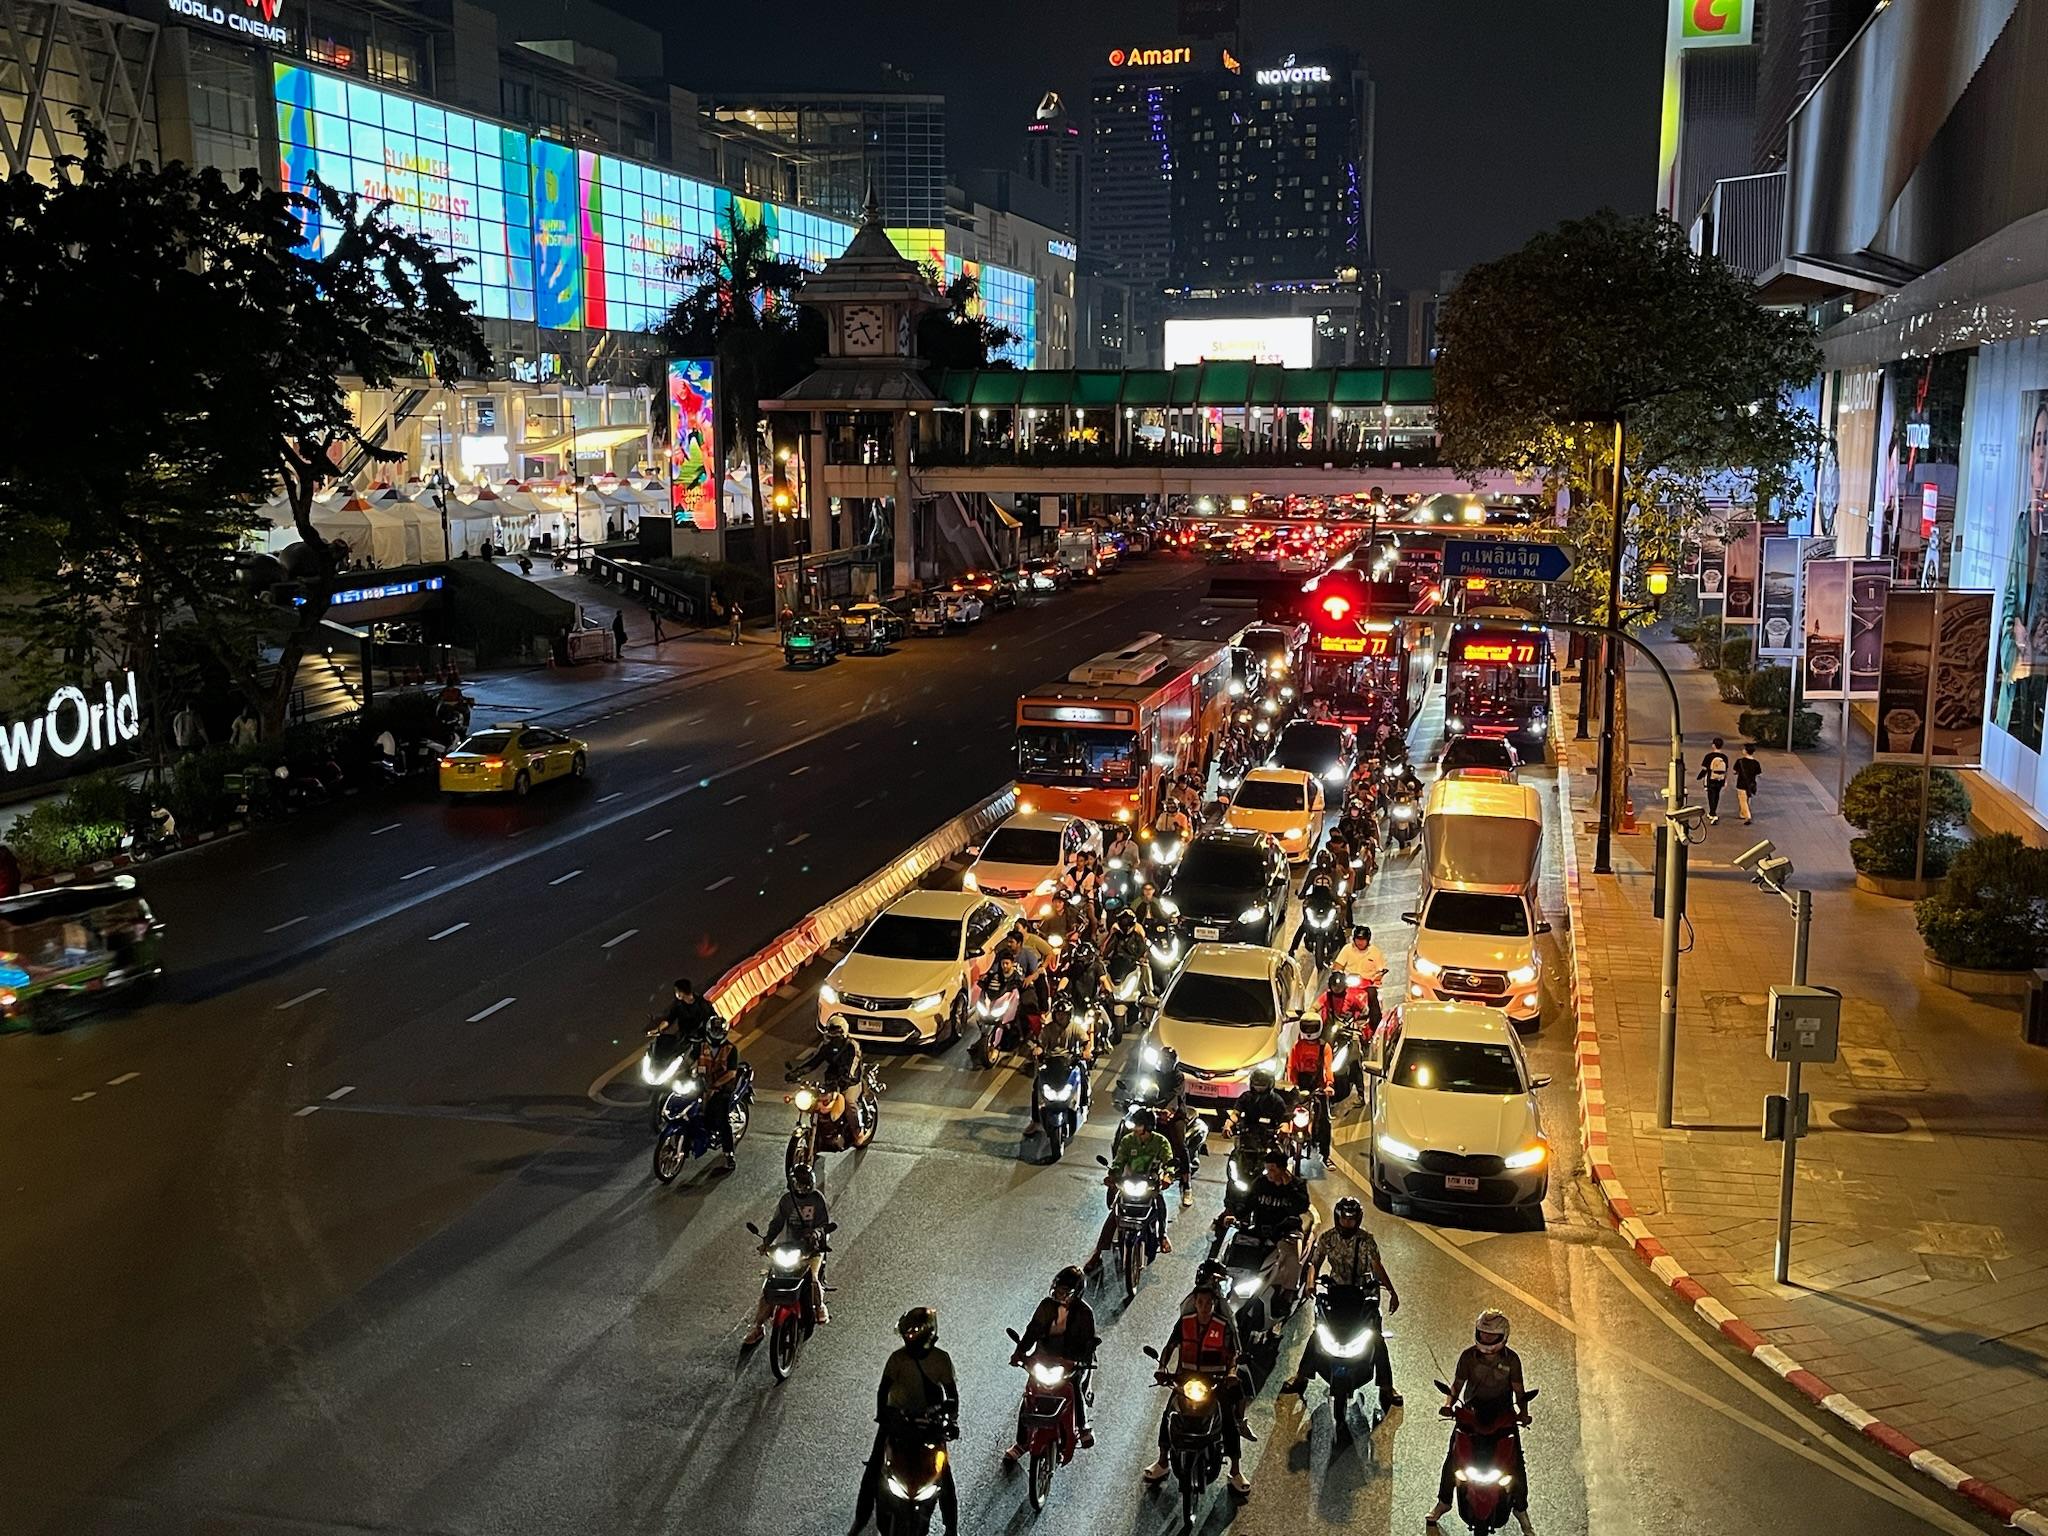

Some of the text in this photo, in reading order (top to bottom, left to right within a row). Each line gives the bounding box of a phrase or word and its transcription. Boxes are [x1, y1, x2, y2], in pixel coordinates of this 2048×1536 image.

[168, 0, 287, 45] WORLD CINEMA
[1127, 47, 1191, 66] Amari
[1256, 66, 1332, 85] NOVOTEL
[1843, 371, 1880, 410] HUBLOT
[1906, 423, 1931, 449] TUDOR
[1497, 566, 1517, 576] Chit
[1371, 638, 1388, 656] 77
[1517, 645, 1534, 662] 77
